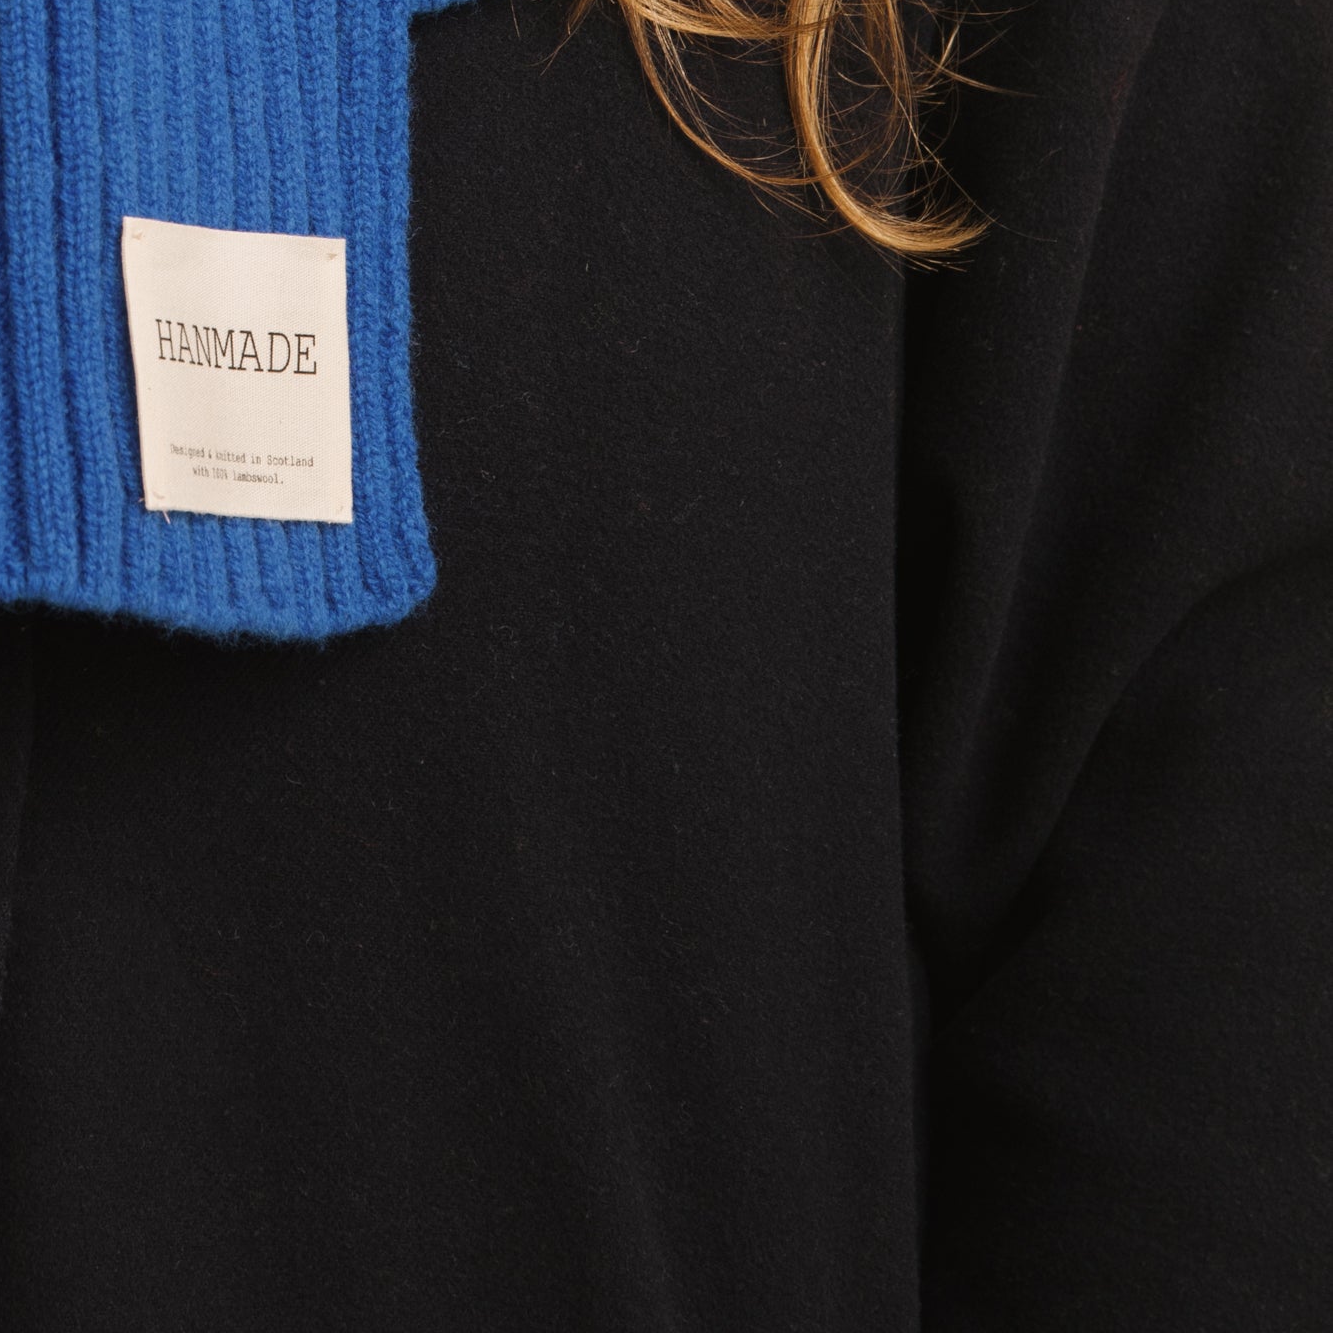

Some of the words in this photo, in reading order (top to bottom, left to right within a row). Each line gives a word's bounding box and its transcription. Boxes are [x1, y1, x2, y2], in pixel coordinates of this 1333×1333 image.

[156, 318, 317, 375] HANMADE
[251, 452, 262, 465] in
[267, 454, 314, 467] Scotland
[192, 465, 210, 478] with
